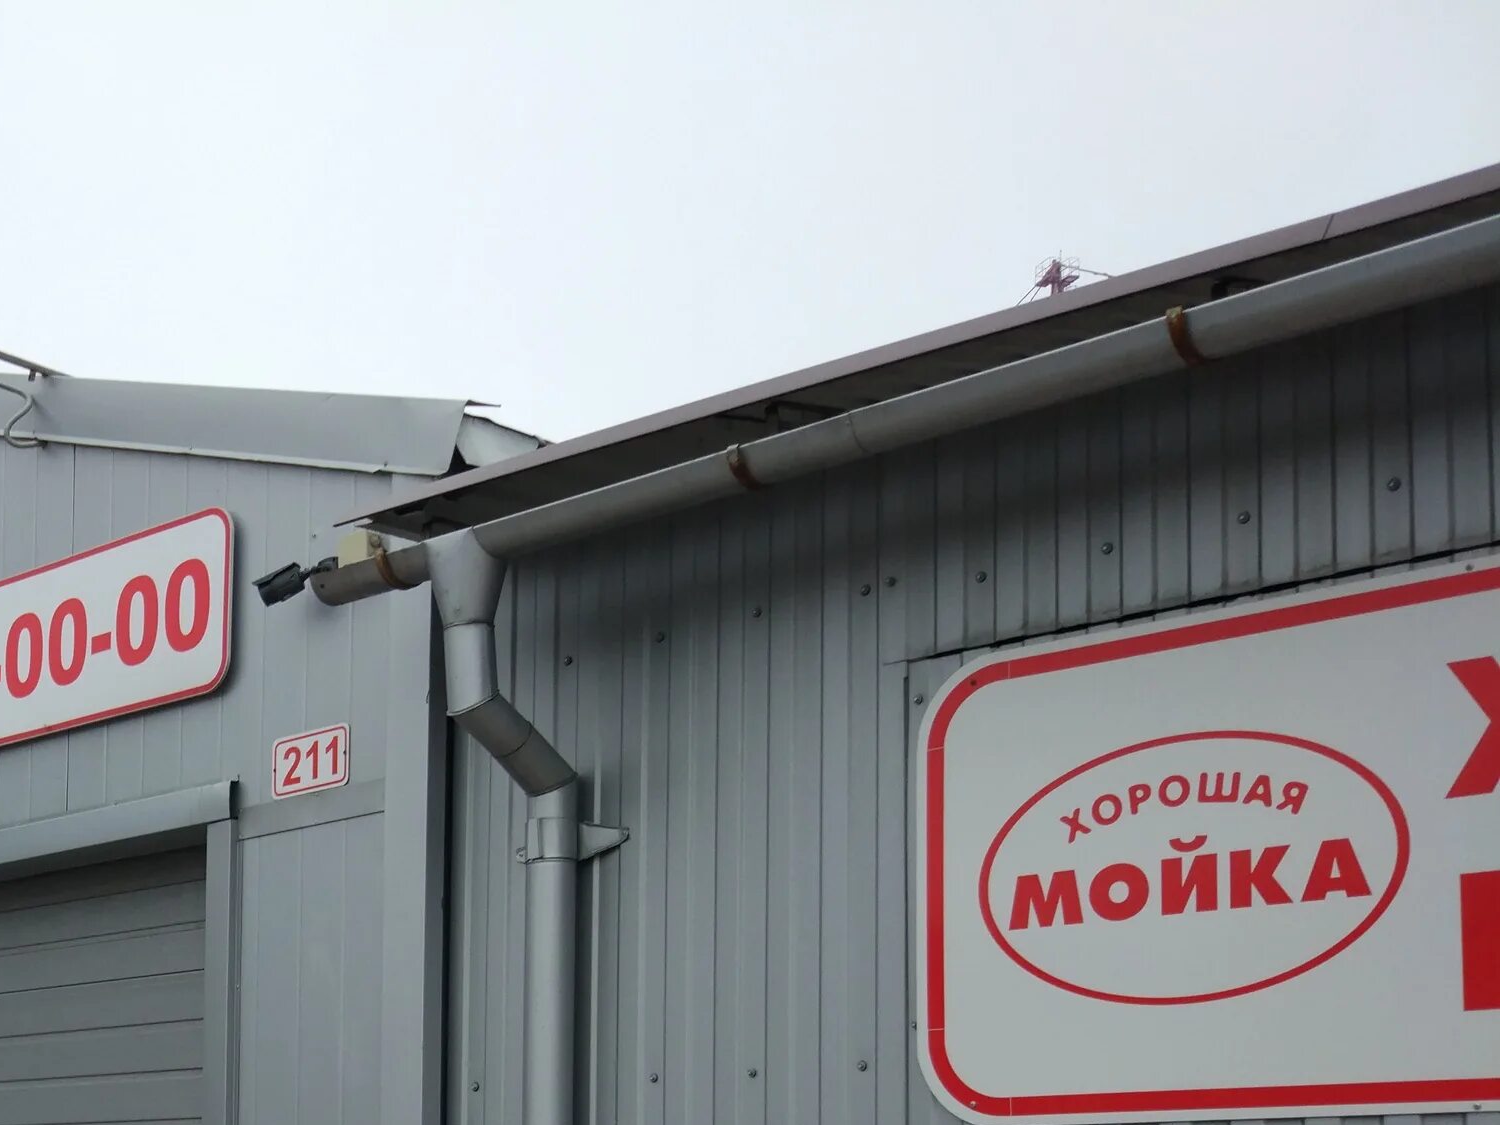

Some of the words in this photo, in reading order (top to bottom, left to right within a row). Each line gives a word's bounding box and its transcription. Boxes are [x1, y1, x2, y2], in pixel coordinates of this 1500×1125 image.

[282, 735, 339, 787] 211
[1059, 771, 1310, 844] ХОРОШАЯ
[1008, 834, 1373, 931] МОЙКА
